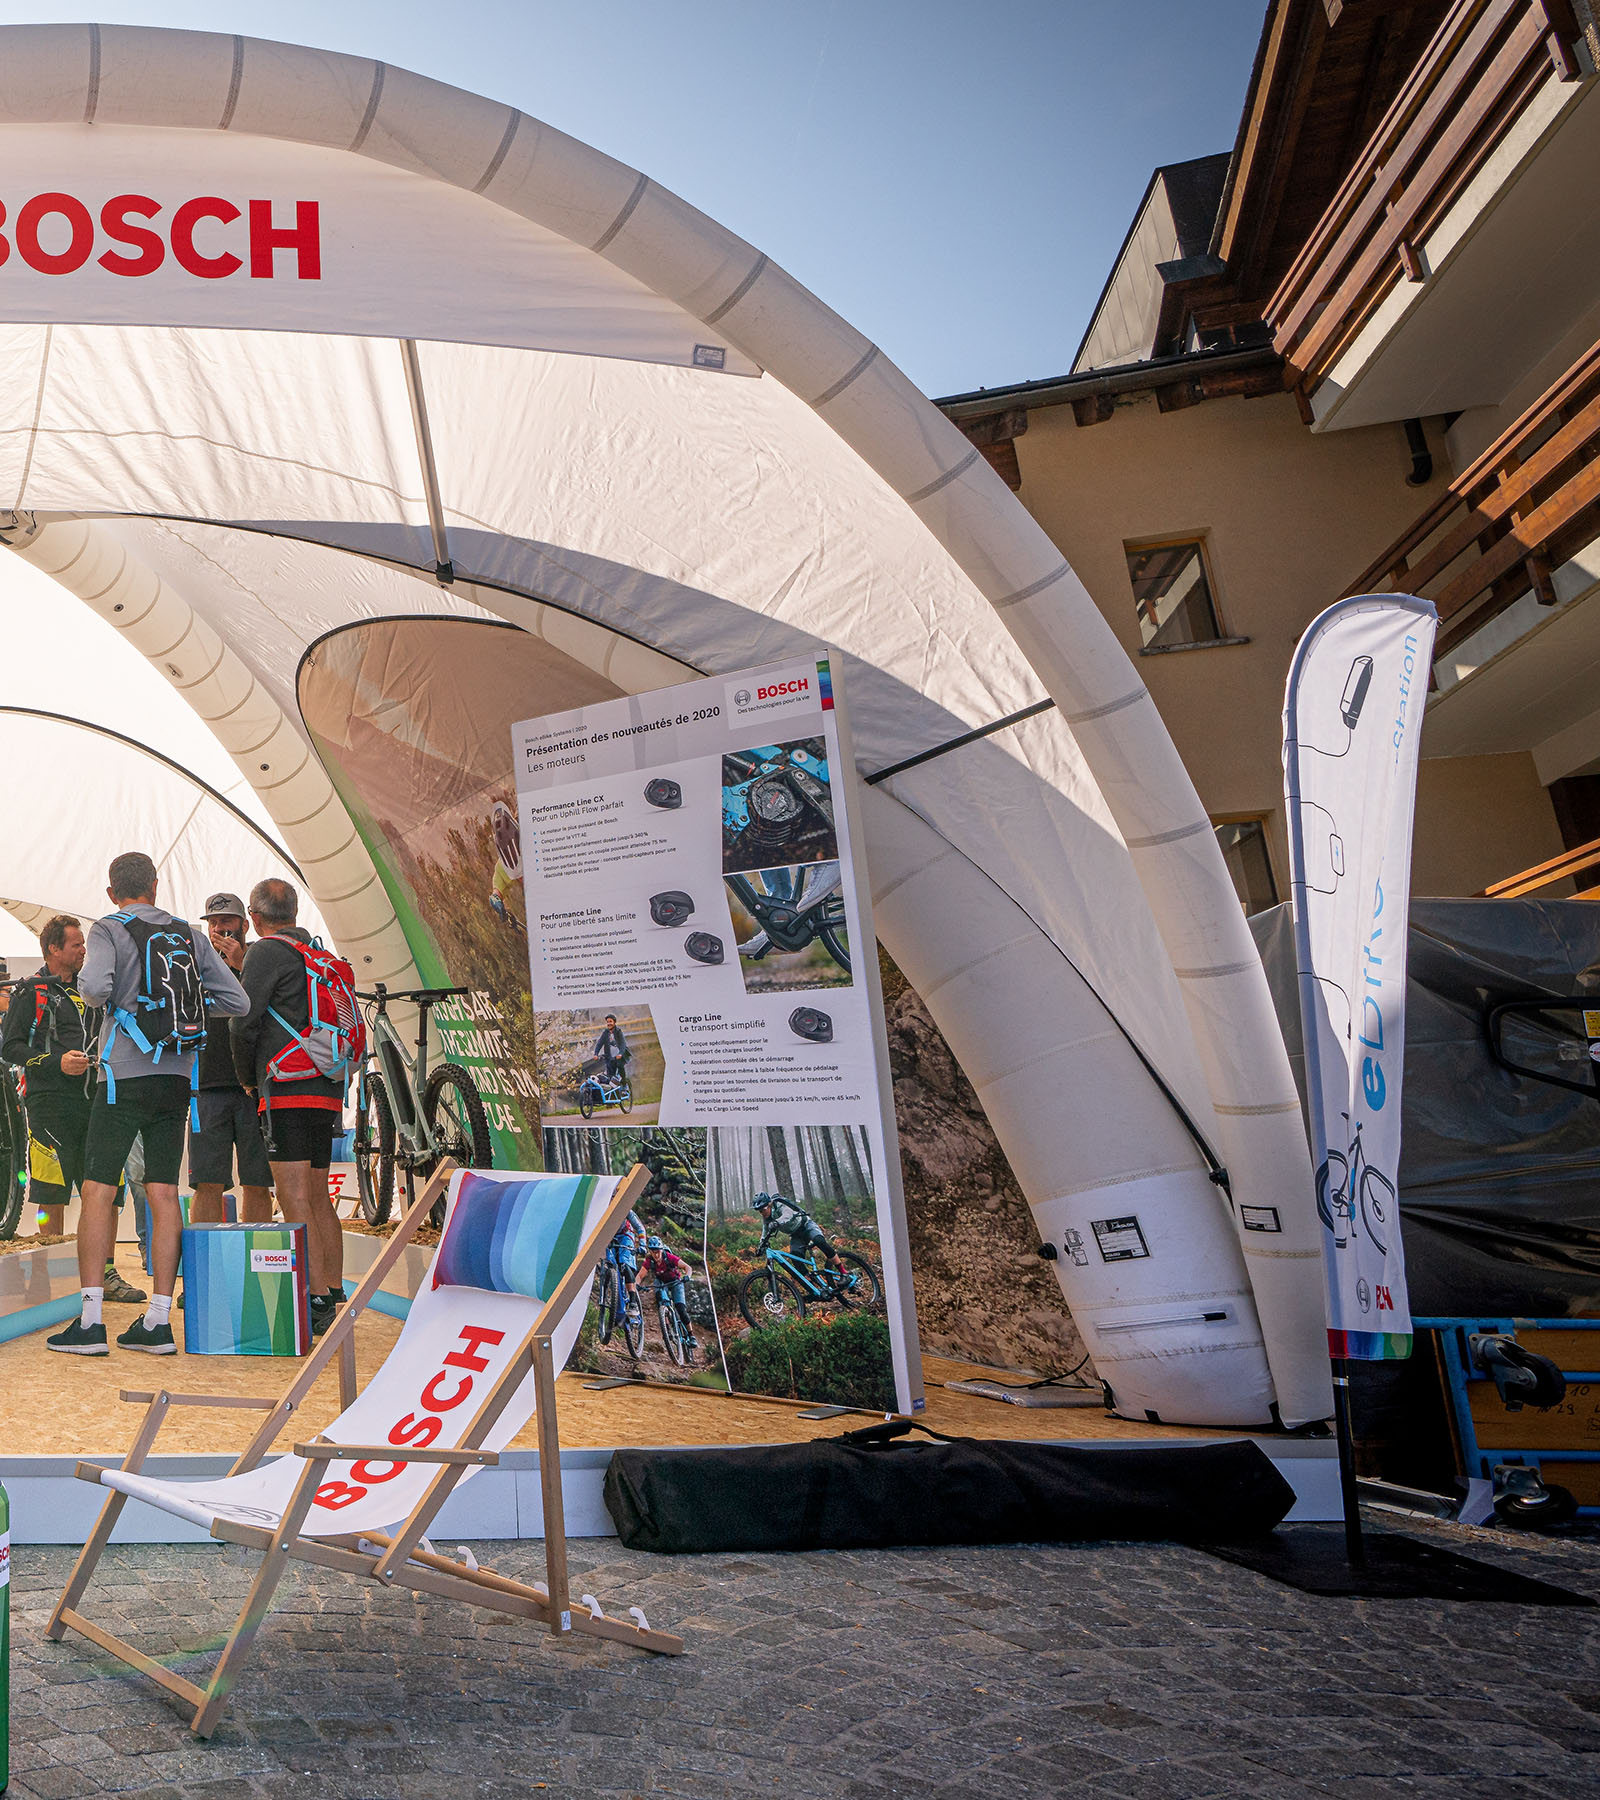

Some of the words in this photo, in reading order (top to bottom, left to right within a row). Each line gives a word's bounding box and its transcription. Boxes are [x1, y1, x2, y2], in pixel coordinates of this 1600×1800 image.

[757, 678, 809, 700] BOSCH
[747, 701, 781, 712] technologies
[782, 698, 795, 706] pour
[526, 737, 589, 757] Présentation
[589, 733, 608, 743] des
[611, 718, 671, 738] nouveautés
[675, 714, 691, 724] de
[692, 706, 720, 720] 2020
[527, 762, 545, 772] Les
[545, 754, 585, 768] moteurs
[531, 801, 575, 814] Performance
[576, 798, 591, 806] Line
[593, 794, 604, 803] CX
[532, 815, 547, 823] Pour
[558, 807, 580, 819] Uphill
[581, 806, 598, 814] Flow
[600, 800, 623, 813] parfait
[540, 910, 584, 921] Performance
[585, 907, 601, 915] Line
[572, 916, 595, 926] liberté
[615, 912, 635, 921] limite
[608, 928, 632, 937] polyvalent
[582, 941, 603, 949] adéquate
[678, 1015, 703, 1023] Cargo
[703, 1013, 721, 1021] Line
[679, 1024, 688, 1032] Le
[690, 1022, 728, 1032] transport
[730, 1020, 765, 1030] simplifié
[709, 1039, 748, 1047] spécifiquement
[312, 1325, 506, 1511] BOSCH
